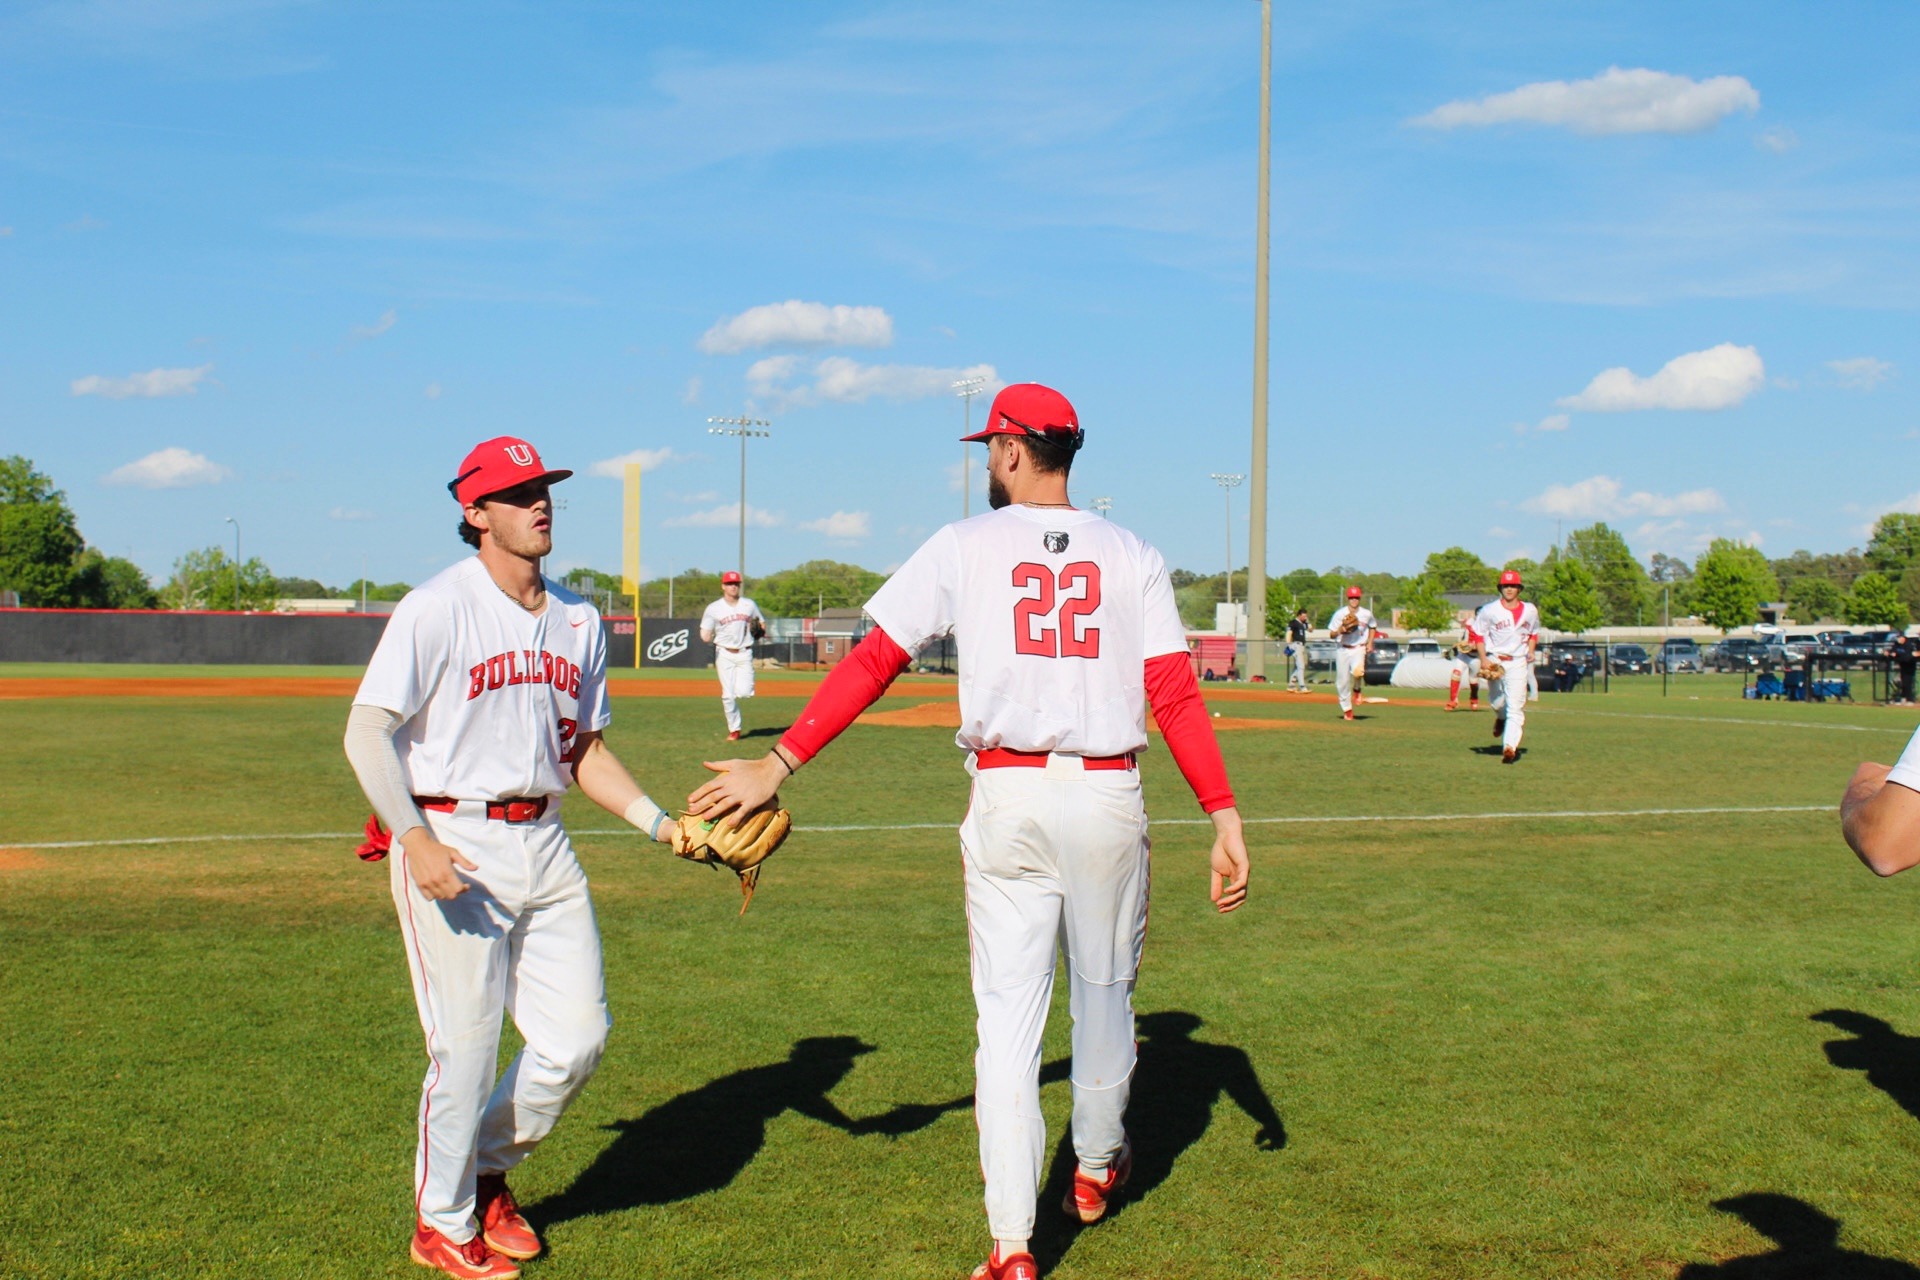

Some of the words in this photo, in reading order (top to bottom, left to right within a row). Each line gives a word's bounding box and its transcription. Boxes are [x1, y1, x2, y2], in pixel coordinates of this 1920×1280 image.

[503, 443, 533, 467] U
[1011, 560, 1101, 659] 22
[647, 628, 689, 661] GSC
